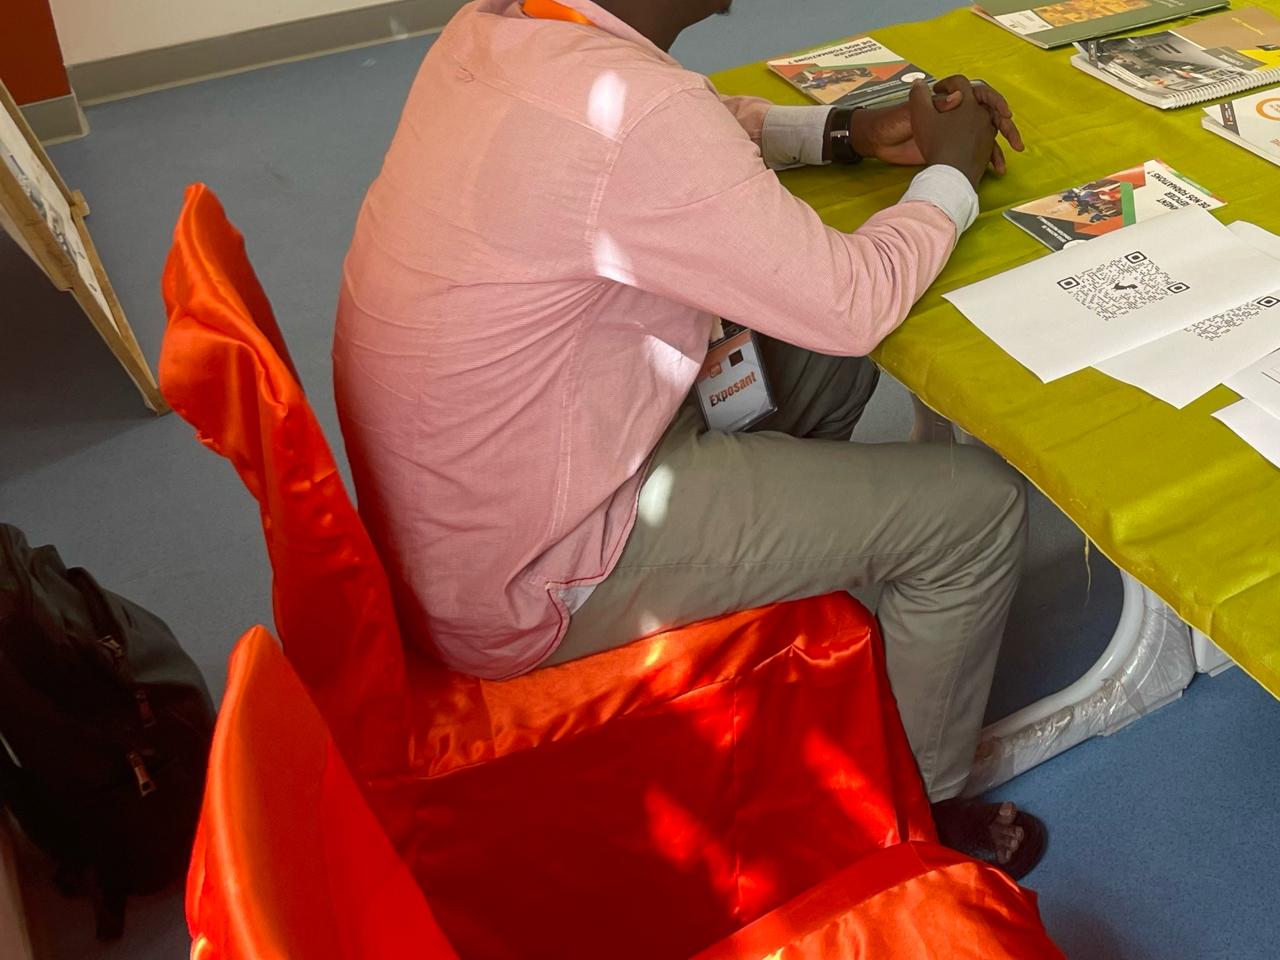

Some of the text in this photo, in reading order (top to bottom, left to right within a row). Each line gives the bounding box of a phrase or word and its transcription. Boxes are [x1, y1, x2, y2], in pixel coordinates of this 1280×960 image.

[794, 47, 844, 63] FORMATIONS
[1151, 173, 1190, 197] FORMATIONS
[1186, 194, 1203, 203] NOS
[708, 371, 757, 408] Exposant
